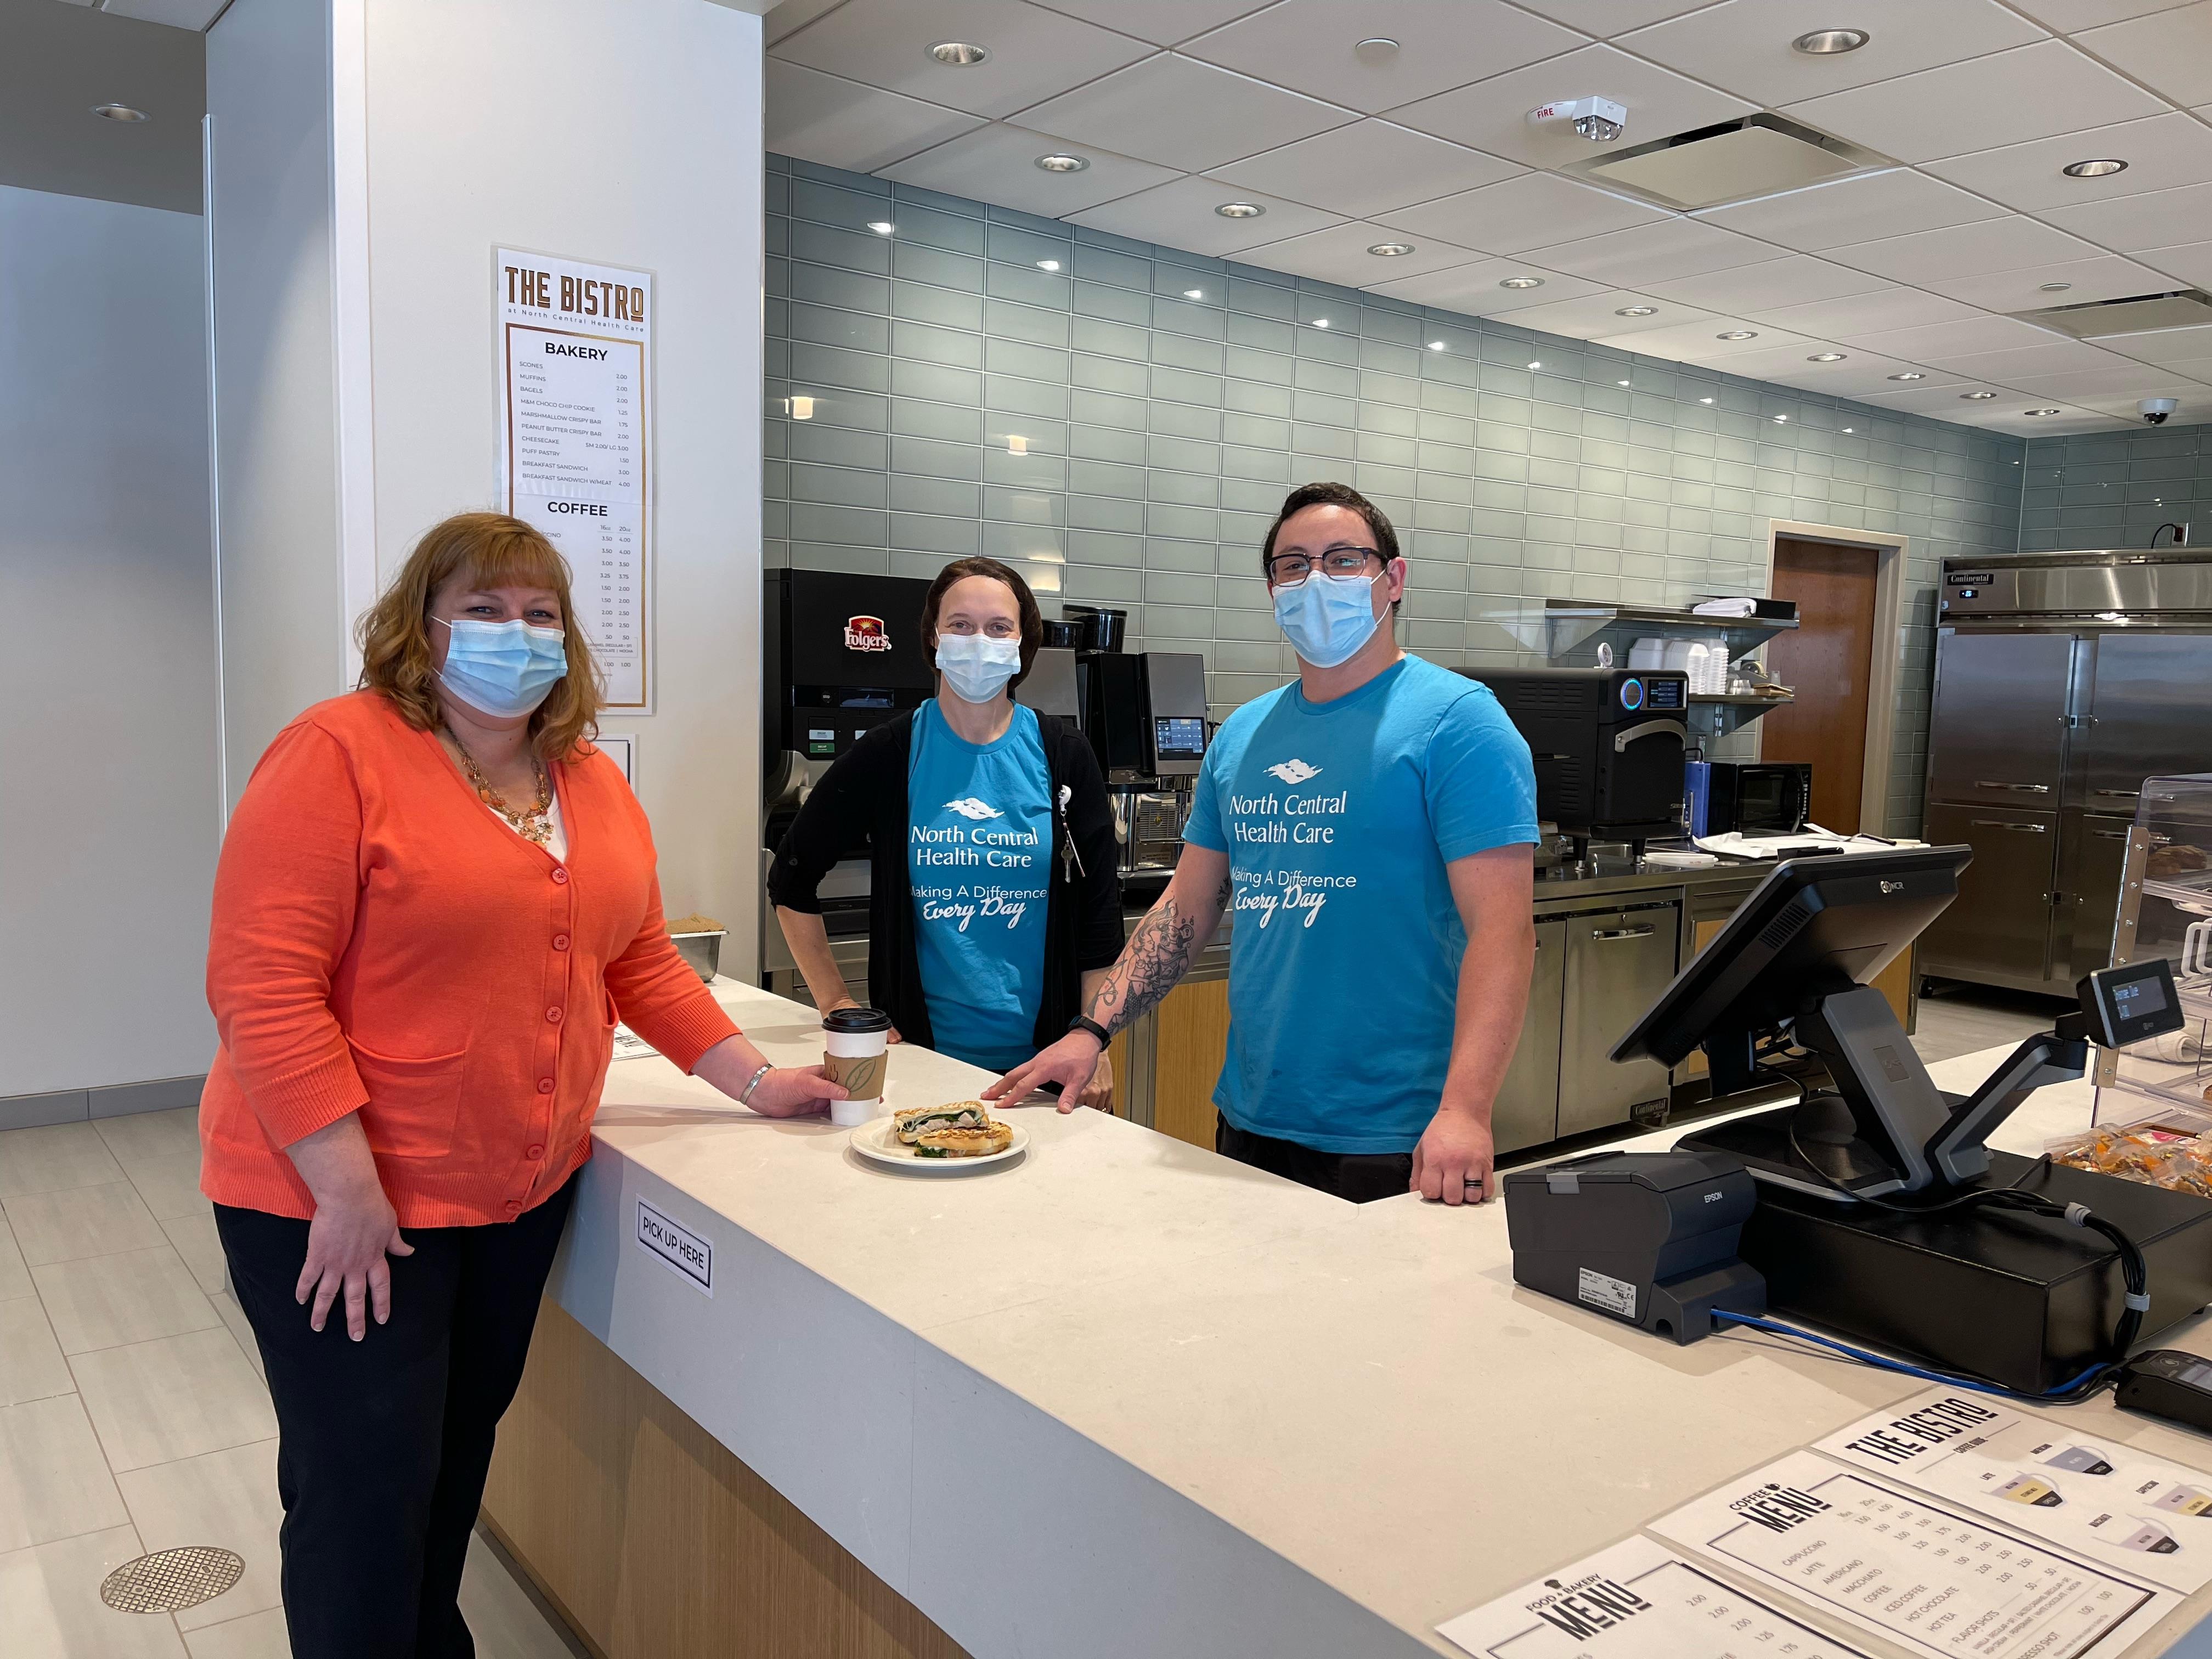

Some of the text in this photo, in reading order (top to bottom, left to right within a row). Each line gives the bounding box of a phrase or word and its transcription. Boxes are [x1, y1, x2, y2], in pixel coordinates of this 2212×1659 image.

[1537, 108, 1554, 119] FIRE
[505, 266, 643, 323] THE BISTRO
[522, 309, 548, 318] North
[552, 314, 586, 324] Central
[591, 320, 620, 329] Health
[625, 324, 644, 332] Care
[545, 342, 608, 361] BAKERY
[521, 411, 567, 421] MARSHMALLOW
[522, 436, 560, 444] CHEESECAKE
[548, 501, 608, 516] COFFEE
[1951, 574, 1989, 583] Continental
[844, 627, 889, 651] Folgers
[1229, 791, 1347, 815] North Central
[911, 825, 1039, 846] North Central
[1234, 821, 1334, 843] Health Care
[917, 848, 1032, 868] Health Care
[1264, 870, 1274, 884] A
[1278, 870, 1357, 888] Difference
[956, 885, 969, 898] A
[974, 885, 1047, 899] Difference
[923, 896, 1026, 933] Every Day
[1235, 884, 1327, 929] Every Day
[1705, 1192, 1723, 1203] EPSON
[643, 1216, 704, 1269] PICK UP HERE
[1844, 1398, 1999, 1465] THE BISTRO
[1729, 1489, 1771, 1510] COFFEE
[1737, 1487, 1833, 1533] MENU
[1782, 1540, 1827, 1566] CAPPUCCINO
[1801, 1561, 1826, 1576] LATTE
[1822, 1559, 1863, 1584] AMERICANO
[1842, 1568, 1883, 1594] MACCHIATO
[1525, 1594, 1557, 1612] FOOD
[1562, 1573, 1602, 1595] BAKERY
[1864, 1585, 1893, 1603] COFFEE
[1884, 1584, 1928, 1612] ICED COFFEE
[1537, 1579, 1654, 1641] MENU
[1905, 1587, 1960, 1623] HOT CHOCOLATE
[1927, 1612, 1958, 1633] HOT TEA
[1952, 1624, 1980, 1644] FLAVOR
[1975, 1610, 2000, 1626] SHOTS
[2040, 1632, 2061, 1646] SHOT
